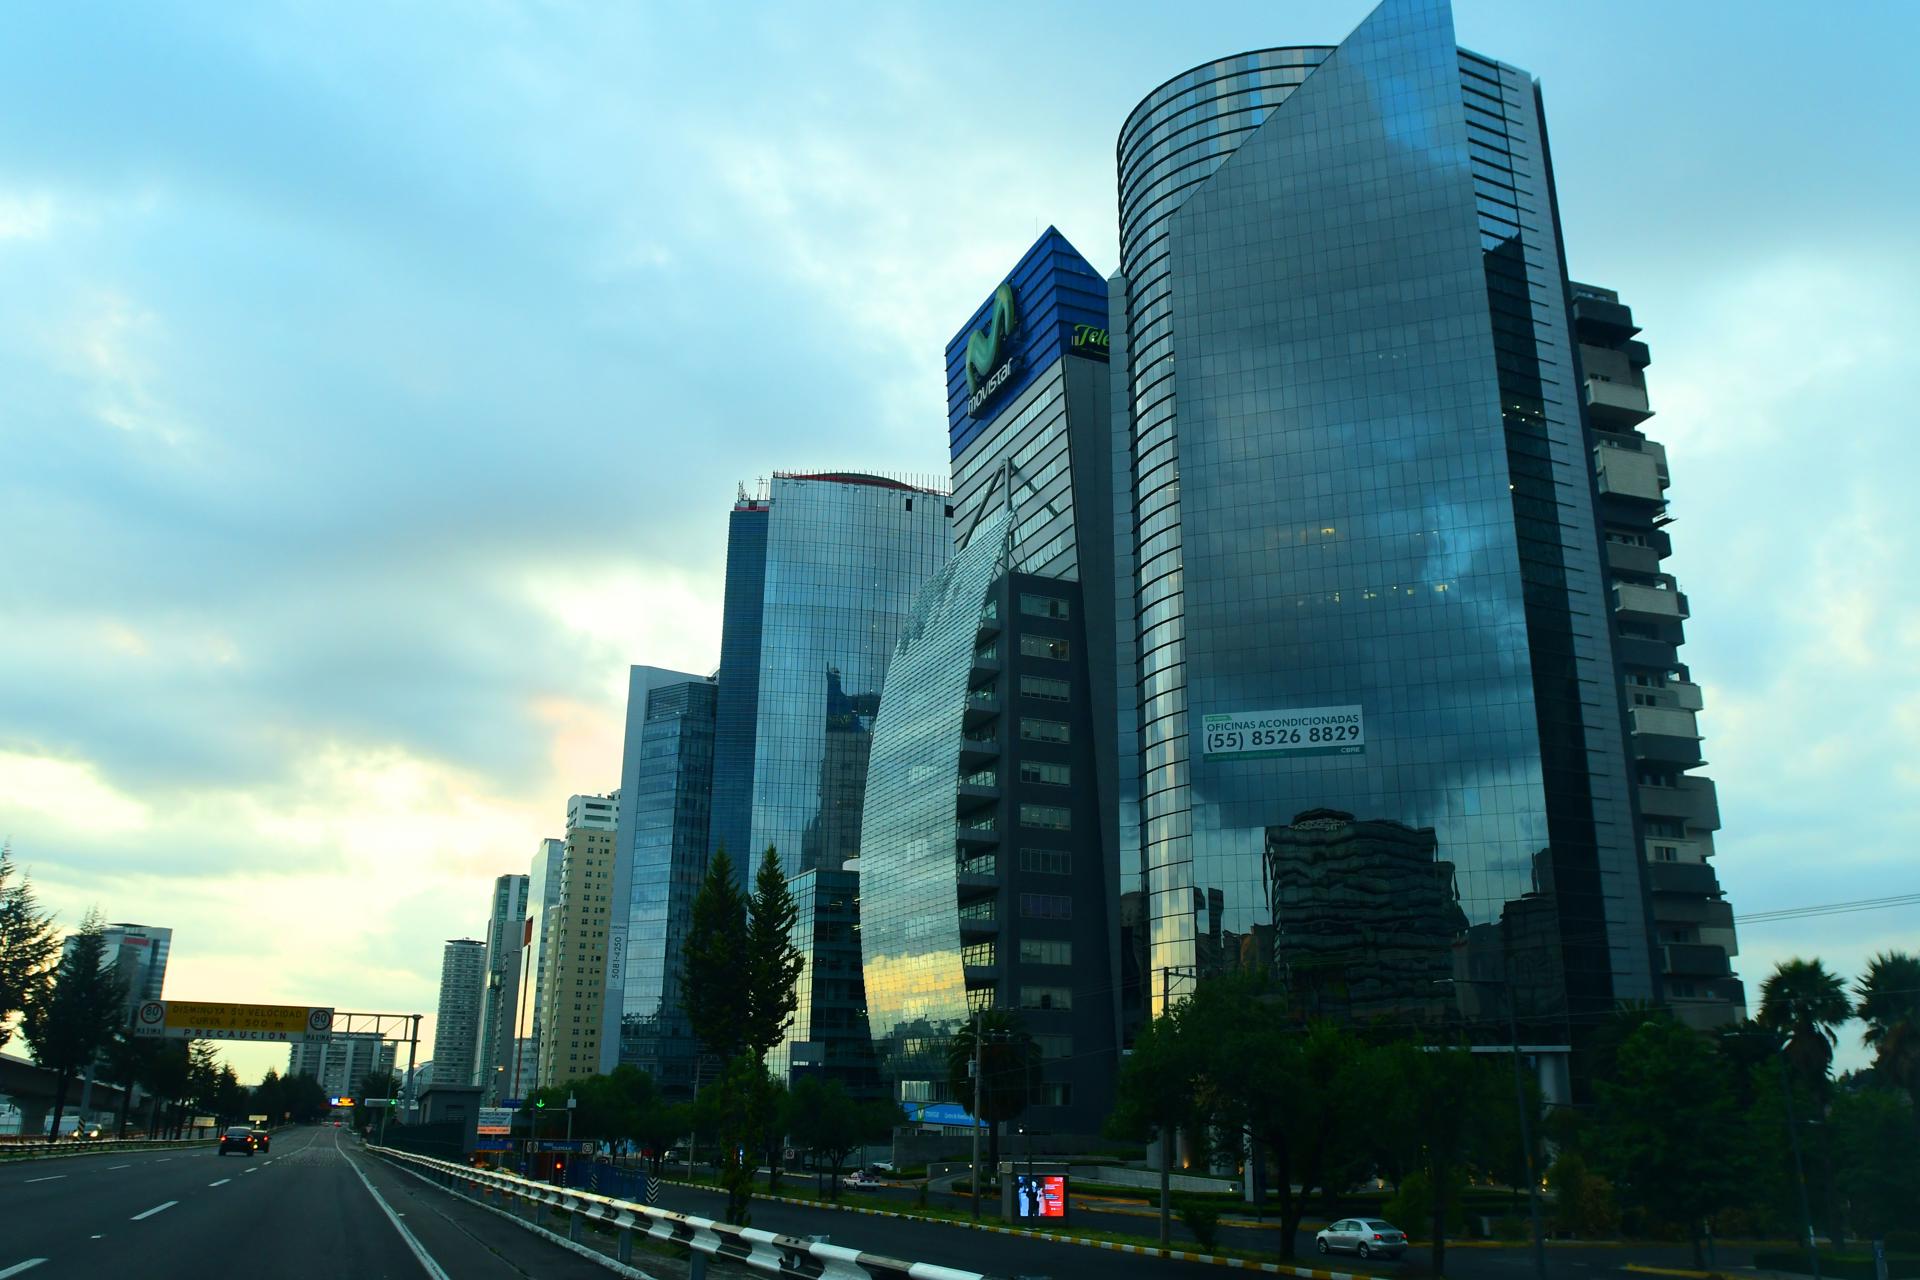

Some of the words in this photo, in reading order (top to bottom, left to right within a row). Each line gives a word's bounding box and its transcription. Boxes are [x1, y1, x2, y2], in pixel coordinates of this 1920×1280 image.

[968, 357, 1013, 415] movistar
[1207, 721, 1256, 732] OFICINAS
[1259, 714, 1359, 728] ACONDICIONADAS
[1207, 732, 1244, 752] (55)
[1251, 729, 1301, 745] 8526
[1309, 725, 1359, 742] 8829
[146, 1007, 158, 1016] 80
[231, 1007, 243, 1016] SU
[248, 1008, 302, 1018] VELOCIDAD
[245, 1019, 267, 1027] 500
[314, 1014, 327, 1024] 80
[184, 1029, 287, 1040] PRECAUCION
